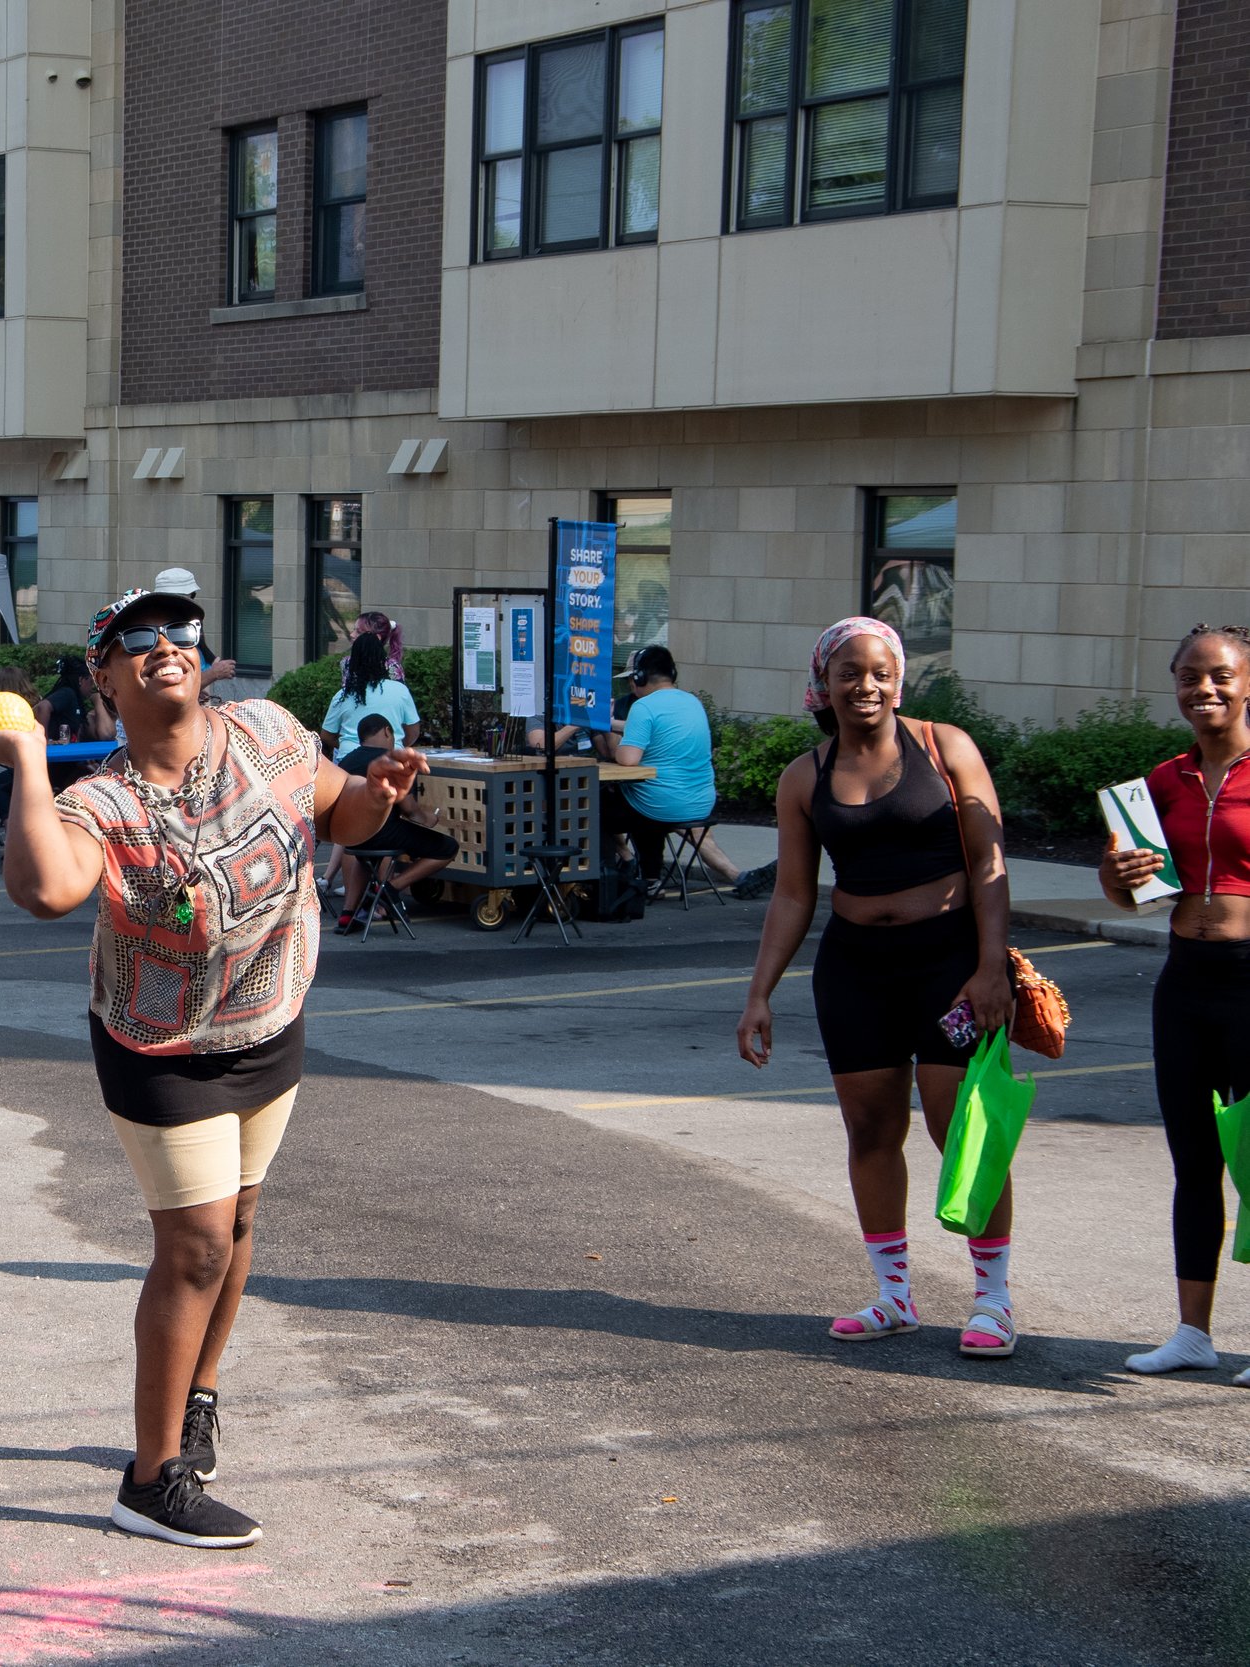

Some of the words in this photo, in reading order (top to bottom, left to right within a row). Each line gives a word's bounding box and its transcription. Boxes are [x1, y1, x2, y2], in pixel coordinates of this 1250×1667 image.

[570, 548, 603, 563] SHARE
[573, 570, 600, 585] YOUR
[569, 593, 602, 608] STORY.
[569, 617, 600, 632] SHAPE
[574, 640, 596, 654] OUR
[571, 662, 597, 677] CITY.
[194, 1392, 213, 1403] FILA
